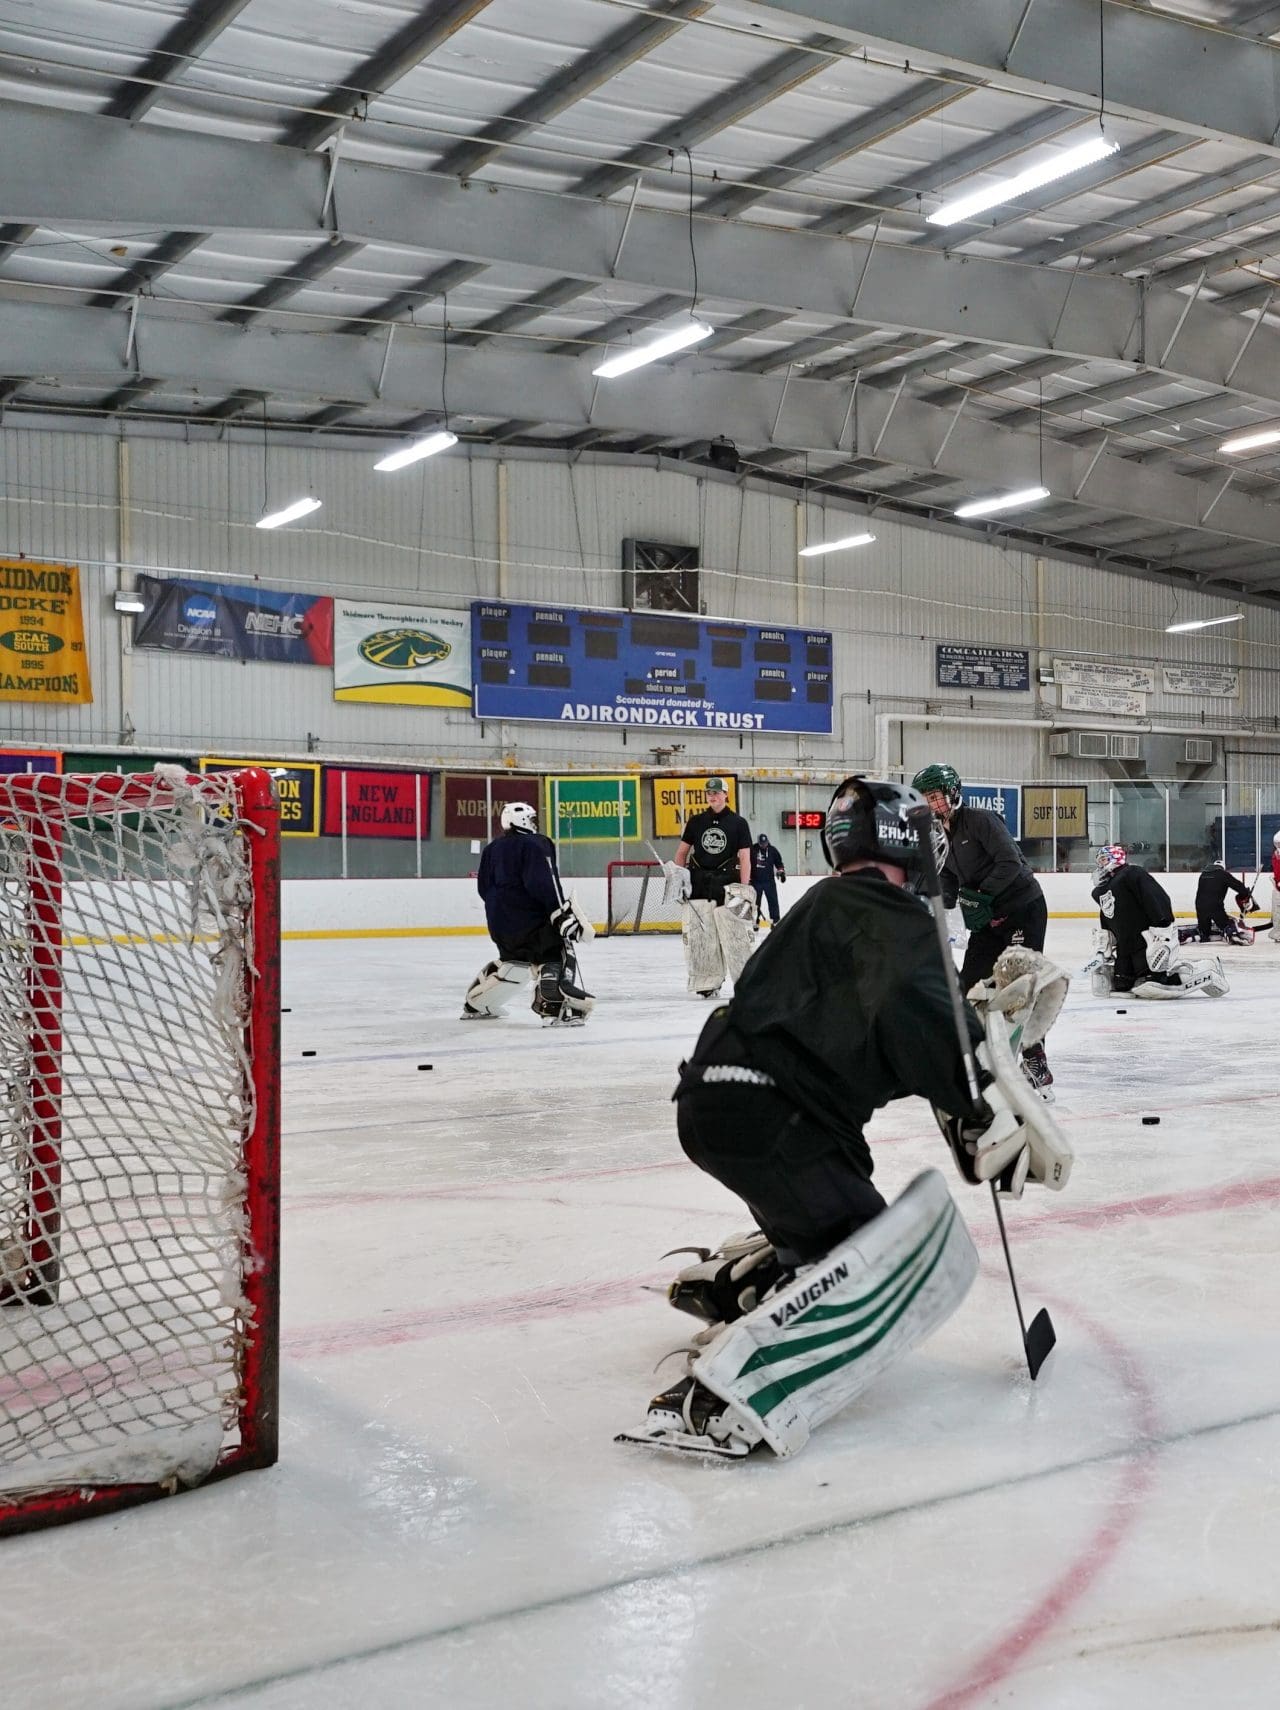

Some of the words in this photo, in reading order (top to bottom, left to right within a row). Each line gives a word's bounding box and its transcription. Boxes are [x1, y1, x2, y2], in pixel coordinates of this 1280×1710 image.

[0, 595, 68, 615] OCKE
[481, 606, 508, 617] player
[186, 608, 216, 619] NCAA
[342, 610, 375, 619] Skidmore
[377, 613, 428, 623] Thoroughbreds
[440, 617, 464, 628] Hockey
[535, 611, 564, 623] penalty
[244, 611, 304, 635] NEHC
[14, 632, 49, 642] ECAC
[760, 630, 785, 641] penalty
[806, 635, 828, 645] player
[13, 641, 50, 652] SOUTH
[481, 648, 508, 659] player
[941, 646, 1025, 659] CONGRATULATIONS
[535, 652, 564, 664] penalty
[654, 667, 678, 678] period
[760, 668, 786, 679] penalty
[807, 672, 828, 682] player
[0, 672, 79, 695] AMPIONS
[646, 683, 664, 693] shots
[673, 685, 686, 694] goal
[615, 694, 664, 708] Scoreboard
[666, 698, 701, 708] donated
[702, 700, 715, 710] by:
[560, 703, 699, 727] ADIRONDACK
[704, 711, 765, 729] TRUST
[358, 784, 399, 803] NEW
[661, 790, 729, 806] SOUTH
[457, 799, 508, 817] NORW
[558, 800, 631, 818] SKIDMORE
[968, 795, 1005, 812] UMASS
[339, 805, 416, 825] ENGLAND
[1033, 806, 1077, 820] SUFOLK
[1184, 975, 1213, 989] CCM
[769, 1261, 850, 1328] VAUGHN
